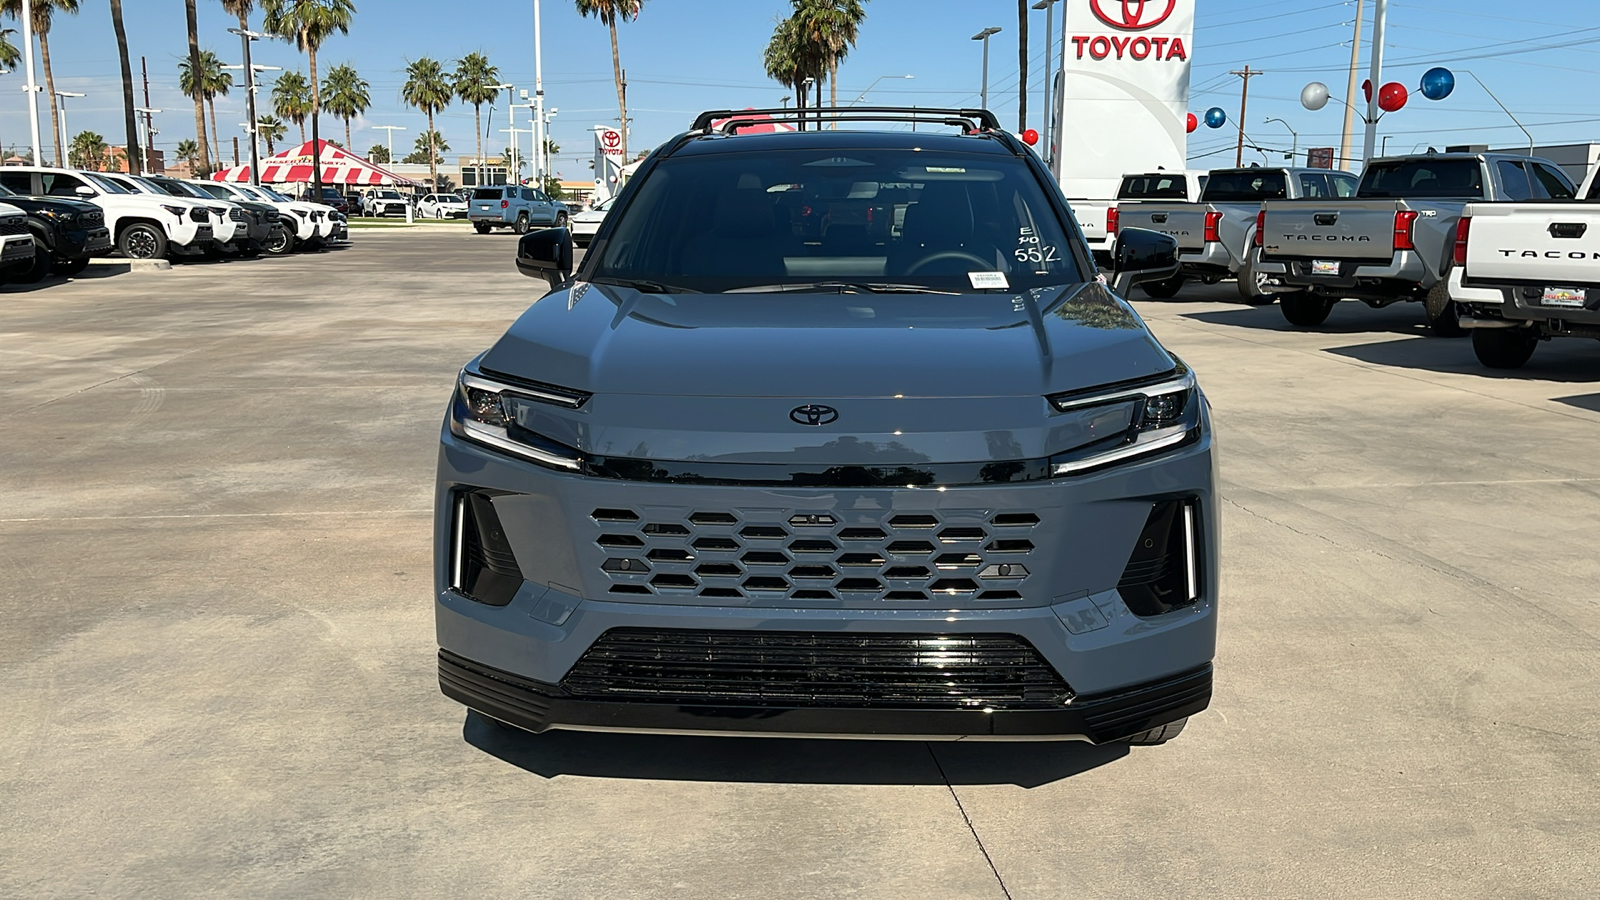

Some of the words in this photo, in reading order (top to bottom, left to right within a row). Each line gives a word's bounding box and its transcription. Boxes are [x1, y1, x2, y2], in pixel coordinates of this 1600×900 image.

[1071, 35, 1187, 61] TOYOTA
[598, 147, 623, 155] TOYOTA
[1020, 226, 1033, 235] E
[1283, 234, 1371, 242] TACOMA
[1014, 245, 1062, 263] 552
